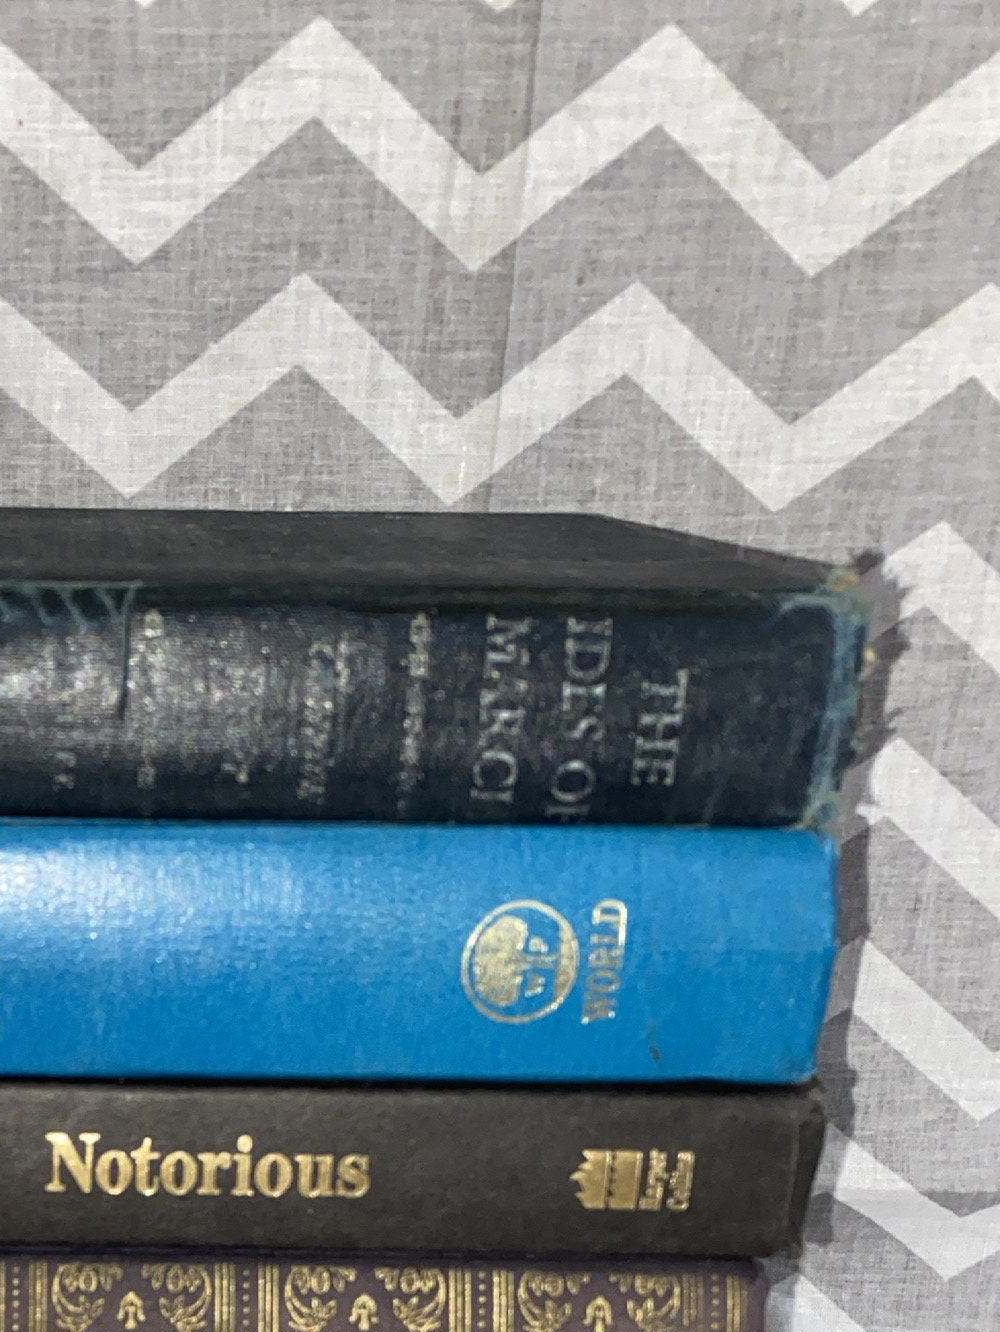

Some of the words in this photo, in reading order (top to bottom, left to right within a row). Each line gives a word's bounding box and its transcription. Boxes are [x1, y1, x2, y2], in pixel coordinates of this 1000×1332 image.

[562, 616, 613, 743] IDES
[630, 667, 690, 788] THE
[580, 898, 628, 1025] WORLD
[44, 1131, 371, 1199] Notorious
